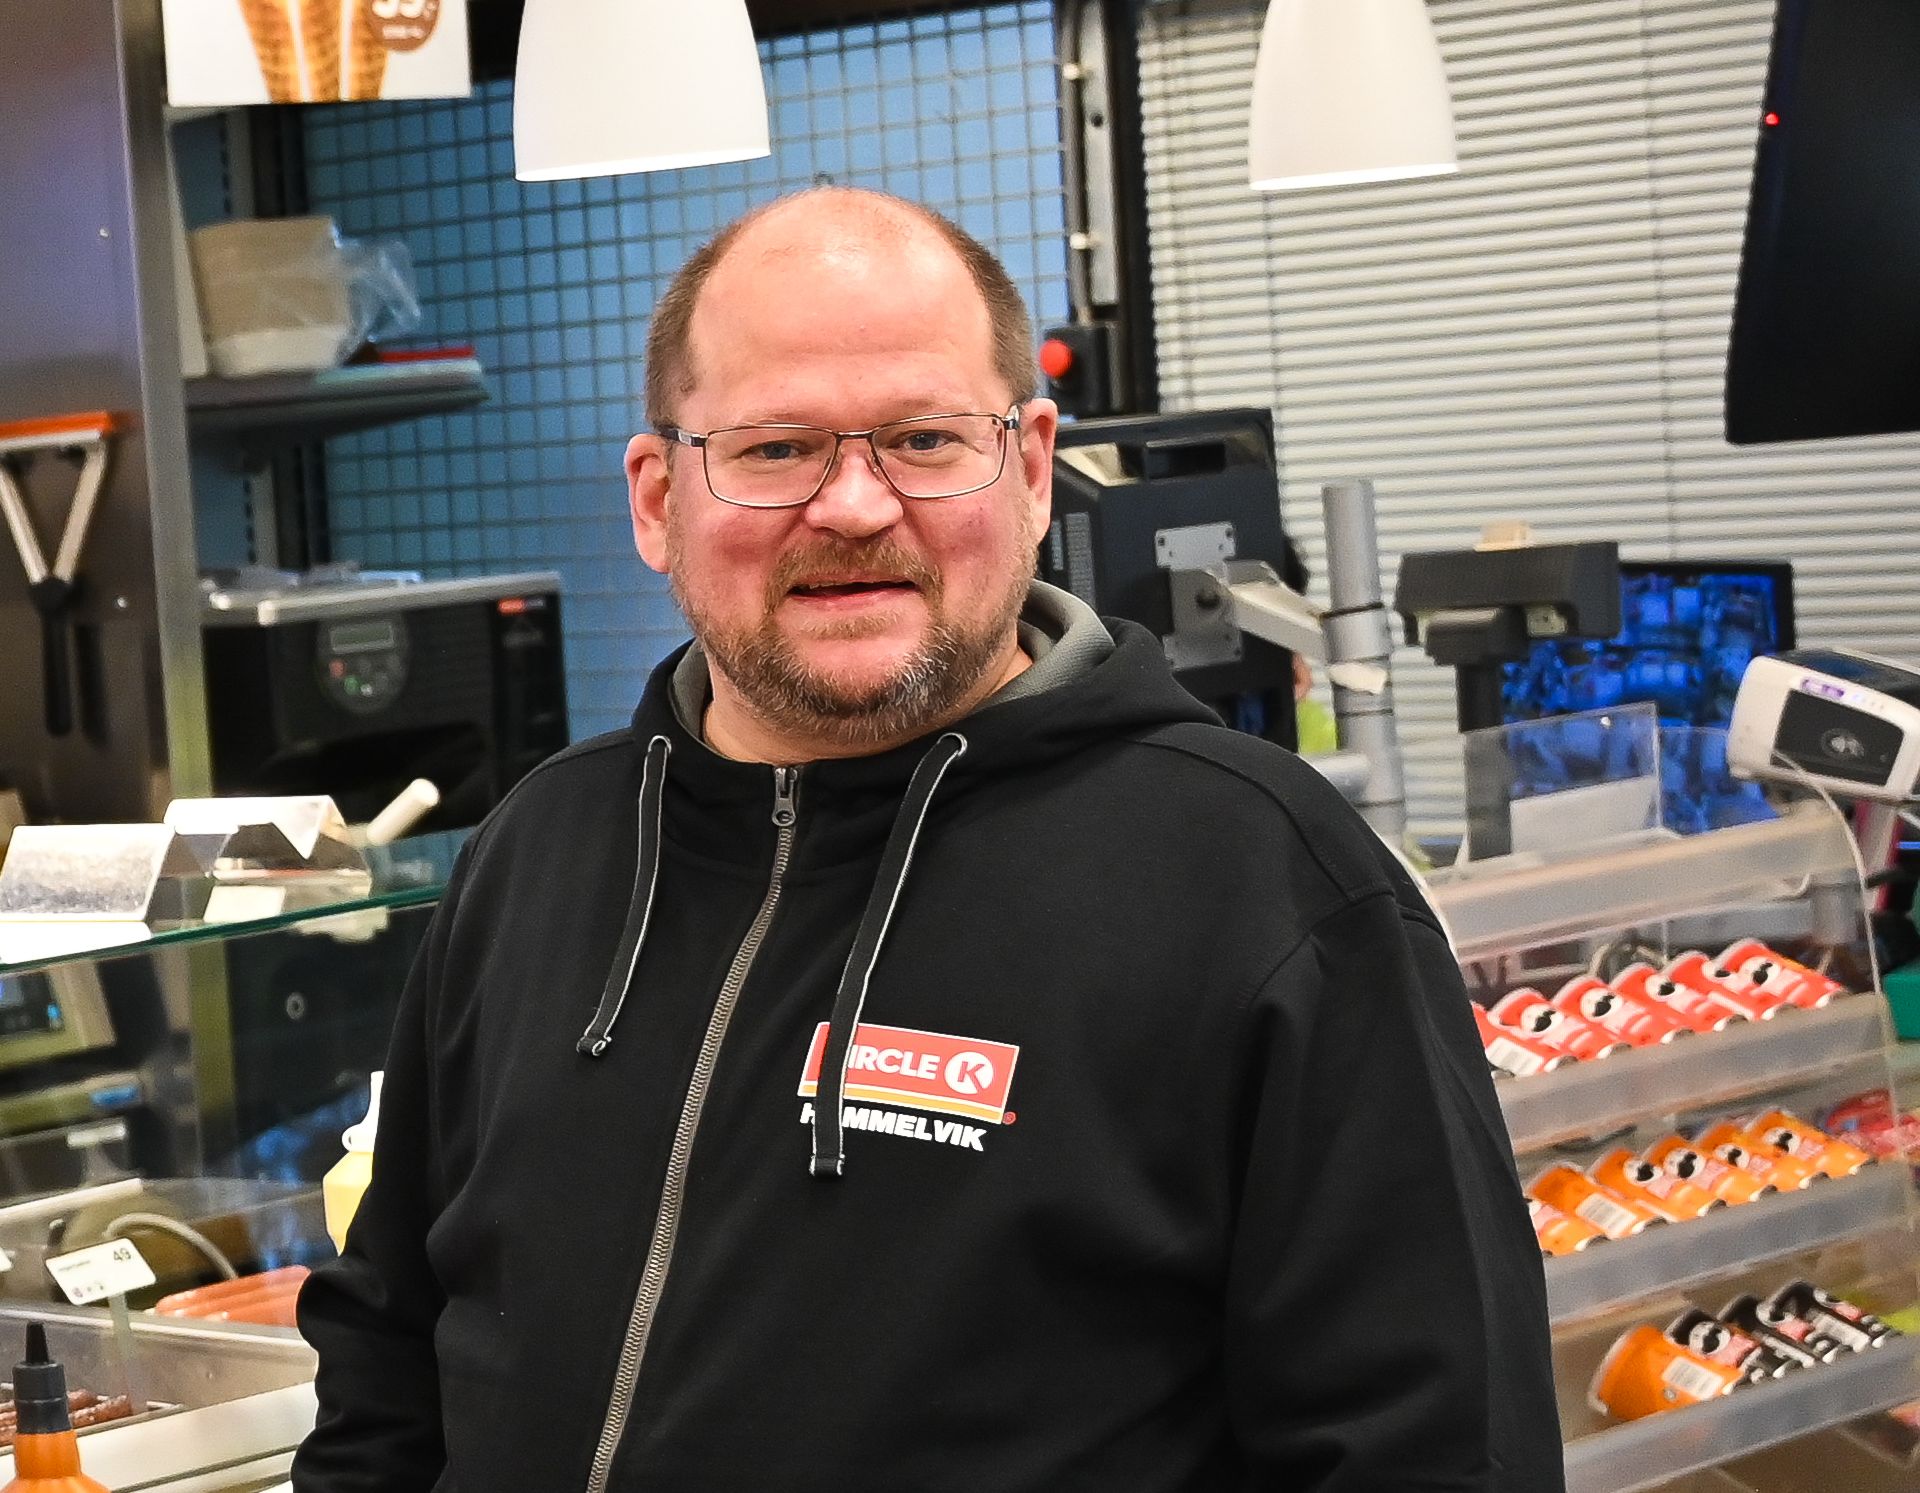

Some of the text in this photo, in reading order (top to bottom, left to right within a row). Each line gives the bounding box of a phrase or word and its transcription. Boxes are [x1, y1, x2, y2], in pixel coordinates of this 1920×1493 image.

[848, 1044, 988, 1095] IRCLE K
[799, 1102, 987, 1152] HMMELVIK
